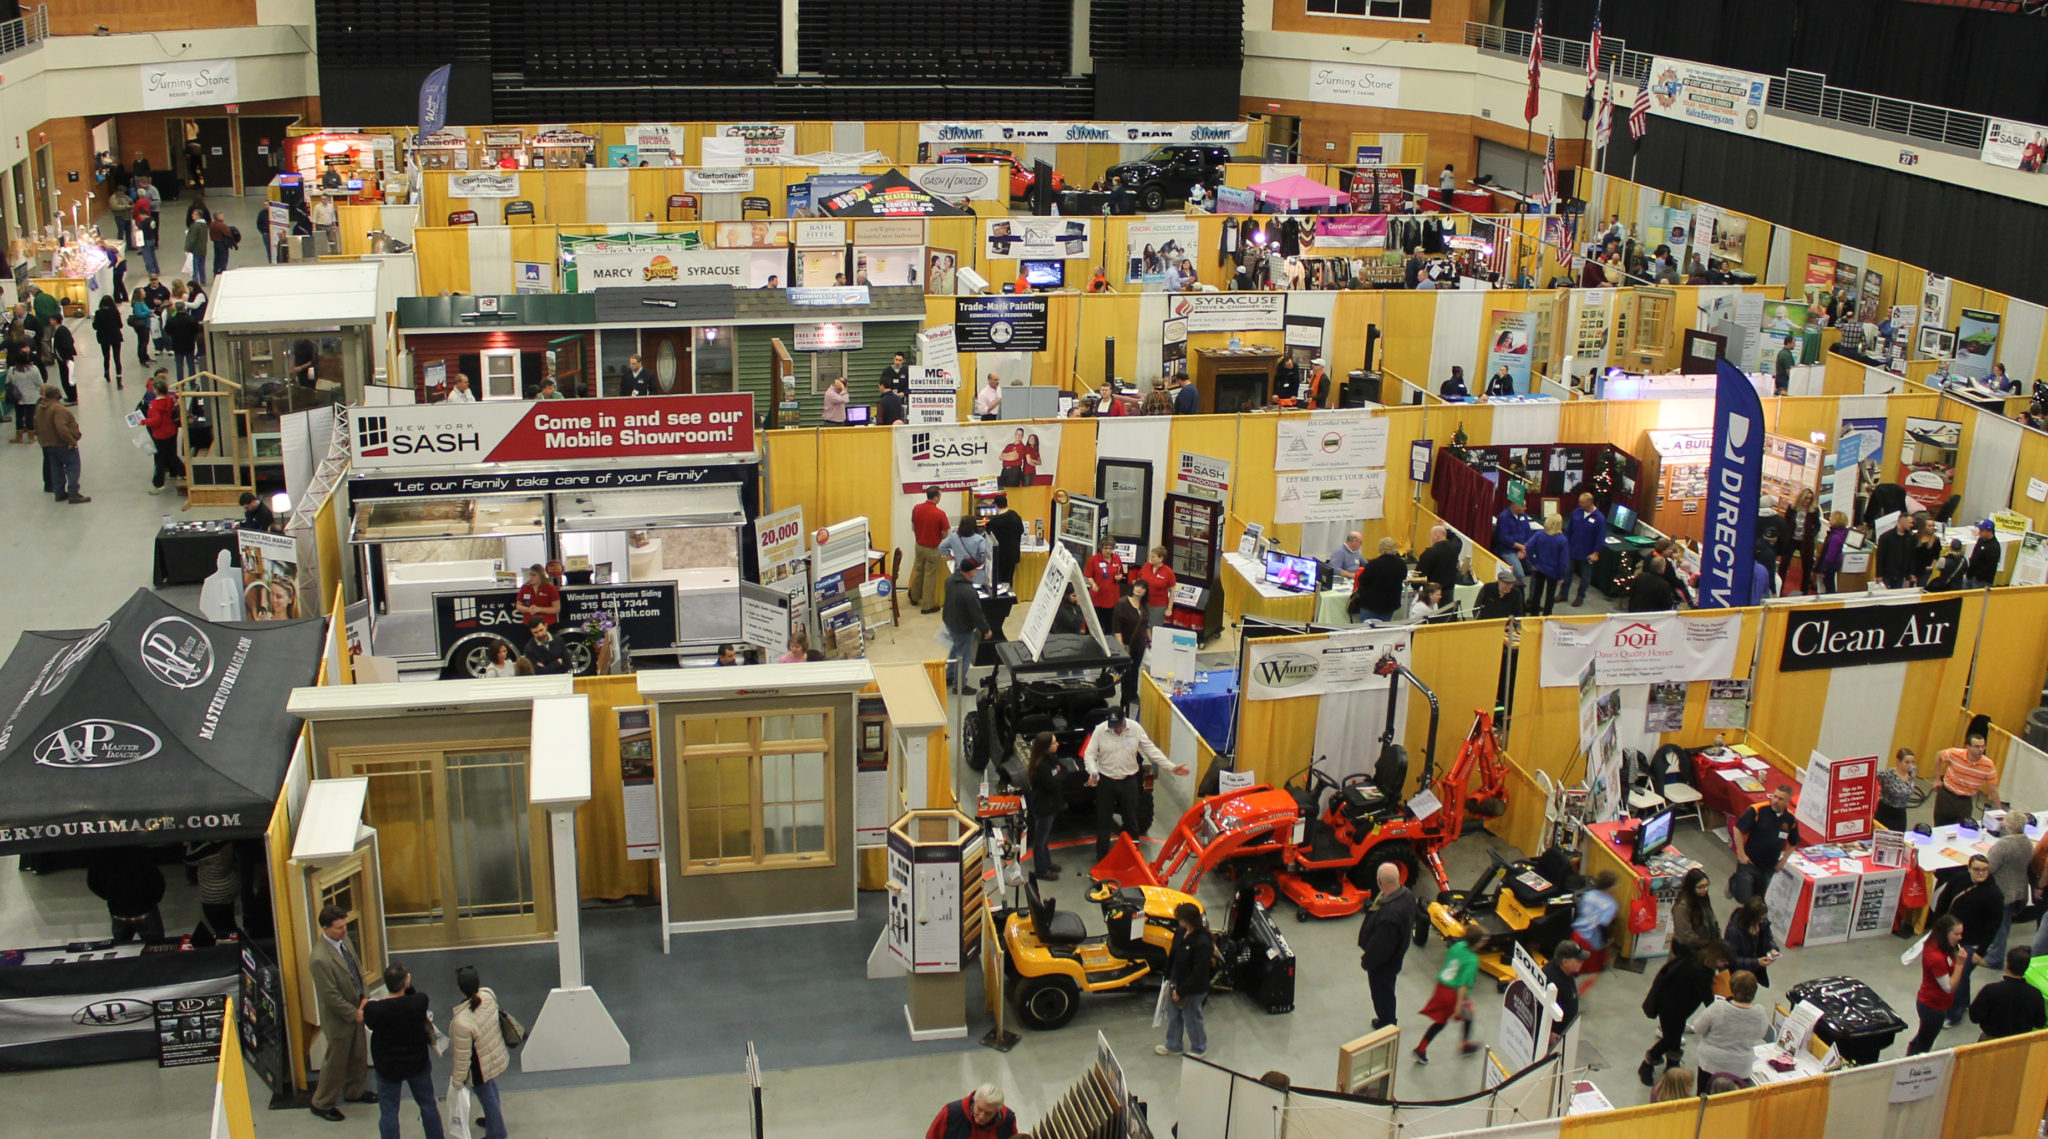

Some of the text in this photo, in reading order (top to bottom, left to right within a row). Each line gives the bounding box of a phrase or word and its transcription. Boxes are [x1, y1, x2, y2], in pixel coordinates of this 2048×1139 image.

[149, 69, 230, 91] Turning Stone
[1315, 70, 1392, 89] Turning Stone
[726, 126, 785, 139] Scott's
[938, 126, 984, 140] SUMMIT
[1066, 125, 1111, 140] SUMMIT
[1190, 125, 1231, 140] SUMMIT
[542, 135, 595, 145] Kitchen Craft
[2000, 134, 2026, 147] SASH
[1901, 154, 1913, 164] 27
[953, 176, 984, 186] DRIZZLE
[1353, 183, 1370, 193] LAS
[1130, 224, 1150, 232] KNOW
[1152, 224, 1175, 232] ADJUST
[593, 269, 633, 278] MARCY
[687, 266, 740, 276] SYRACUSE
[959, 302, 1045, 312] Trade-Mark Painting
[1195, 296, 1277, 305] SYRACUSE
[925, 369, 944, 378] MC
[435, 423, 475, 431] YORK
[534, 410, 743, 431] Come in and see our
[545, 425, 733, 449] Mobile Showroom!
[392, 433, 480, 455] SASH
[932, 442, 988, 458] SASH
[1672, 440, 1712, 450] A BUIL
[1193, 464, 1225, 480] SASH
[430, 482, 457, 492] our
[462, 477, 509, 490] Family
[516, 475, 549, 487] take
[554, 475, 590, 486] care
[595, 472, 611, 484] of
[617, 473, 651, 485] your
[1186, 476, 1221, 489] WINDOWS
[240, 532, 261, 541] PROTECT
[262, 534, 271, 542] AND
[272, 537, 293, 546] MANAGE
[761, 521, 798, 547] 20,000
[1711, 467, 1743, 609] DIRECTV
[566, 590, 662, 601] Windows Bathrooms Siding
[581, 599, 648, 609] 315 7344
[479, 611, 523, 626] SAS
[1791, 612, 1950, 656] Clean Air
[1614, 633, 1657, 649] DQH
[1620, 650, 1646, 658] Quality
[1259, 660, 1318, 685] WHITE'S
[199, 636, 252, 741] MASTERYOURIMAGE.COM
[1656, 684, 1681, 692] MAX
[1717, 680, 1737, 688] MAX
[35, 724, 116, 765] A&P
[101, 742, 140, 751] MASTER
[105, 751, 141, 759] IMAGES
[978, 799, 1017, 811] STIHL
[1268, 811, 1295, 820] KUBOTA
[0, 813, 241, 842] ERYOURIMAGE.COM
[1244, 824, 1272, 835] KUBOTA
[1822, 883, 1848, 893] MAX
[1514, 946, 1546, 988] SOLD
